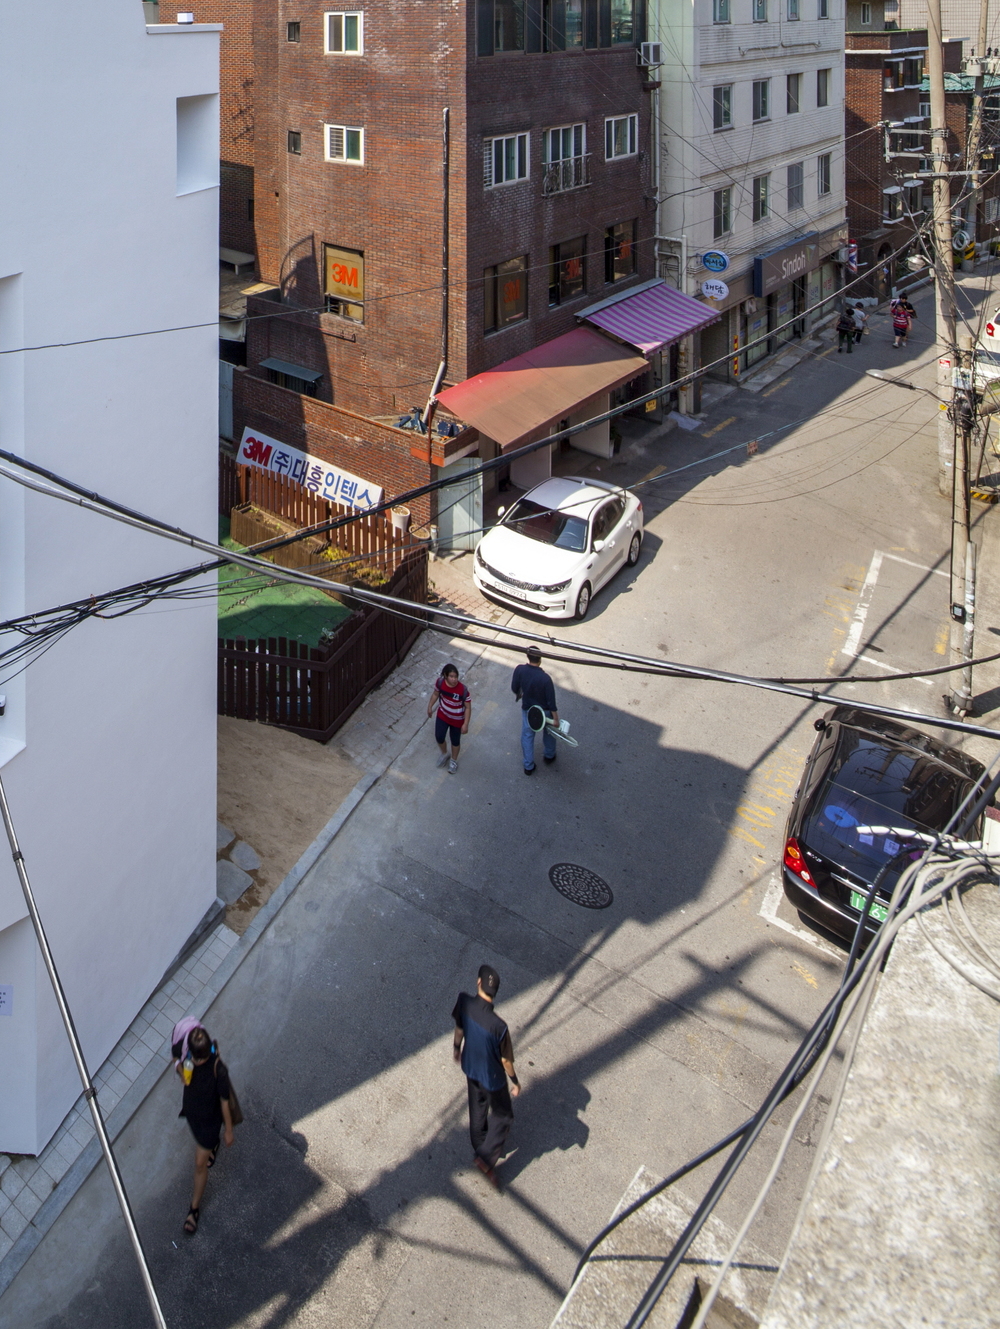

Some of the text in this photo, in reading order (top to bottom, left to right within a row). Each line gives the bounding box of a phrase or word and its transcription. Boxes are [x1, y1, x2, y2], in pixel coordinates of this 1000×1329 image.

[331, 262, 358, 289] 3M
[565, 258, 581, 280] 3M
[781, 251, 806, 280] Sindoh
[503, 278, 521, 304] 3M
[242, 436, 273, 467] 3M
